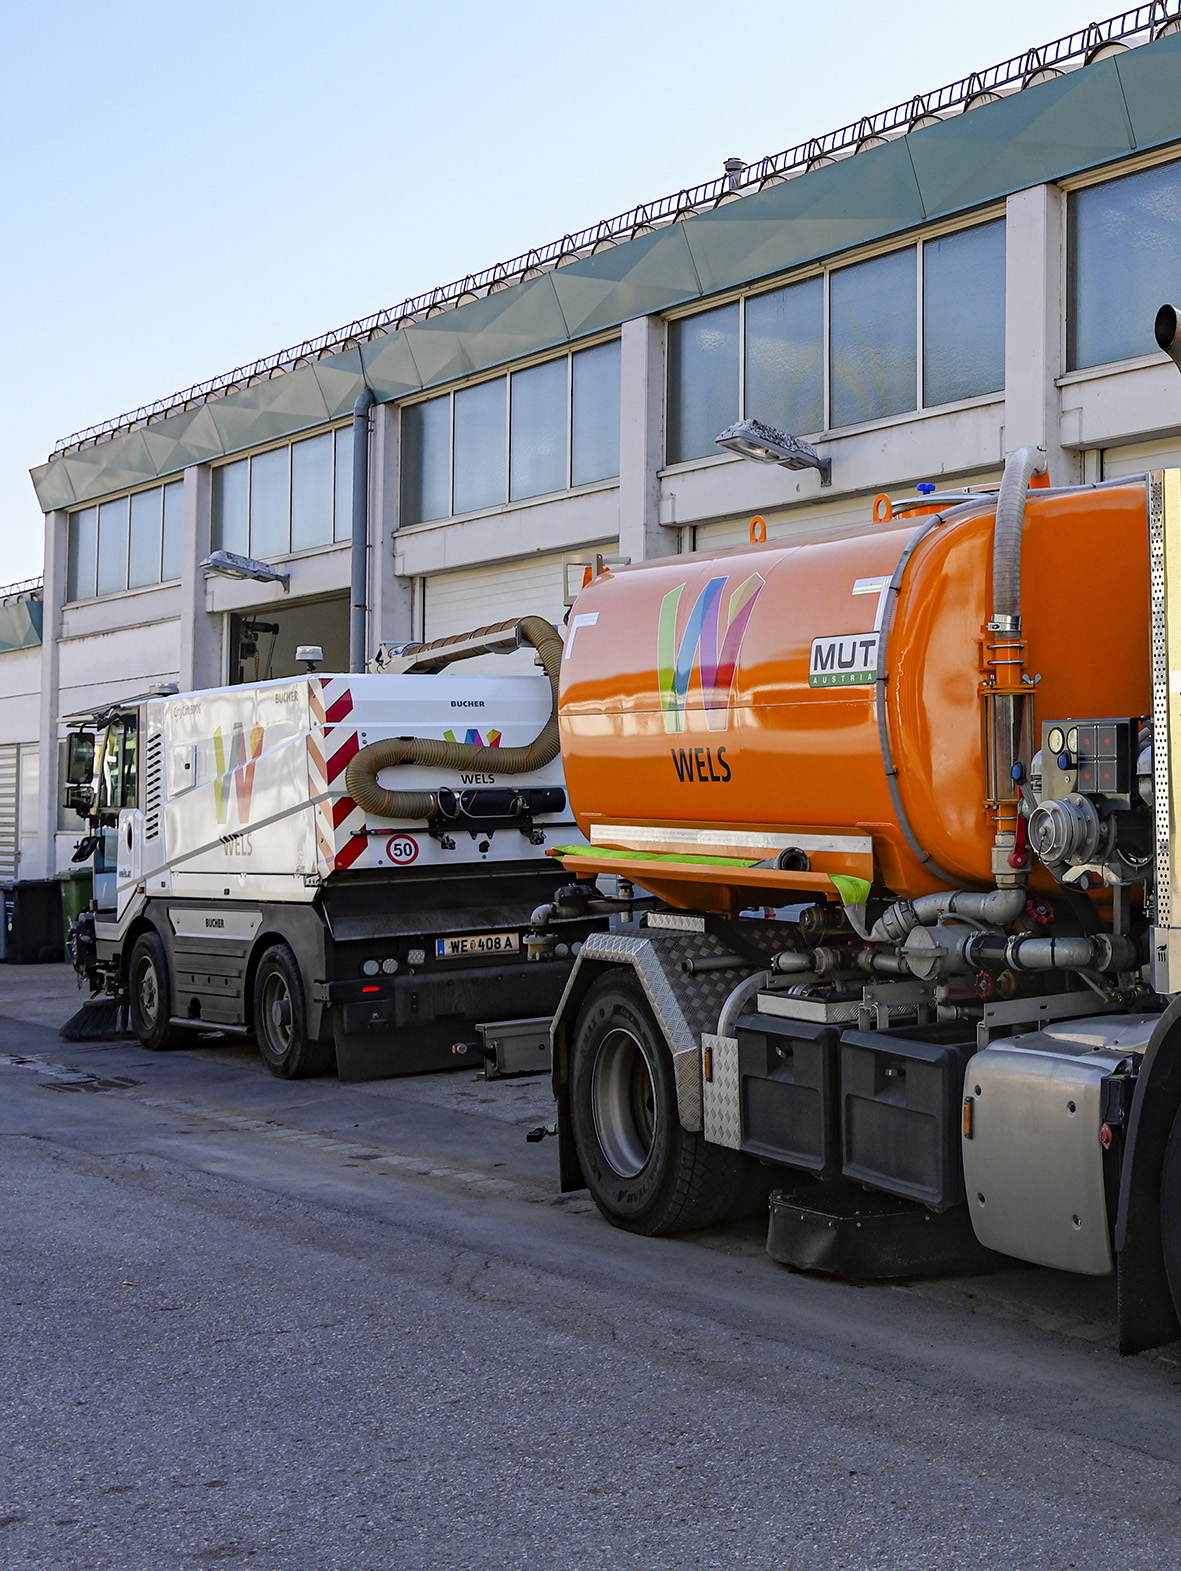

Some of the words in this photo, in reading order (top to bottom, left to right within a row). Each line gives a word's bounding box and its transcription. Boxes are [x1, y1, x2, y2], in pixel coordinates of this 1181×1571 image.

[813, 639, 876, 671] MUT
[812, 673, 873, 684] AUSTRIA
[274, 691, 299, 704] BUCHER
[450, 700, 486, 708] BUCHER
[671, 746, 732, 782] WELS
[460, 773, 496, 784] WELS
[218, 832, 254, 857] WELS
[393, 842, 413, 857] 50
[205, 918, 225, 929] BUCHER
[450, 939, 469, 954] WE
